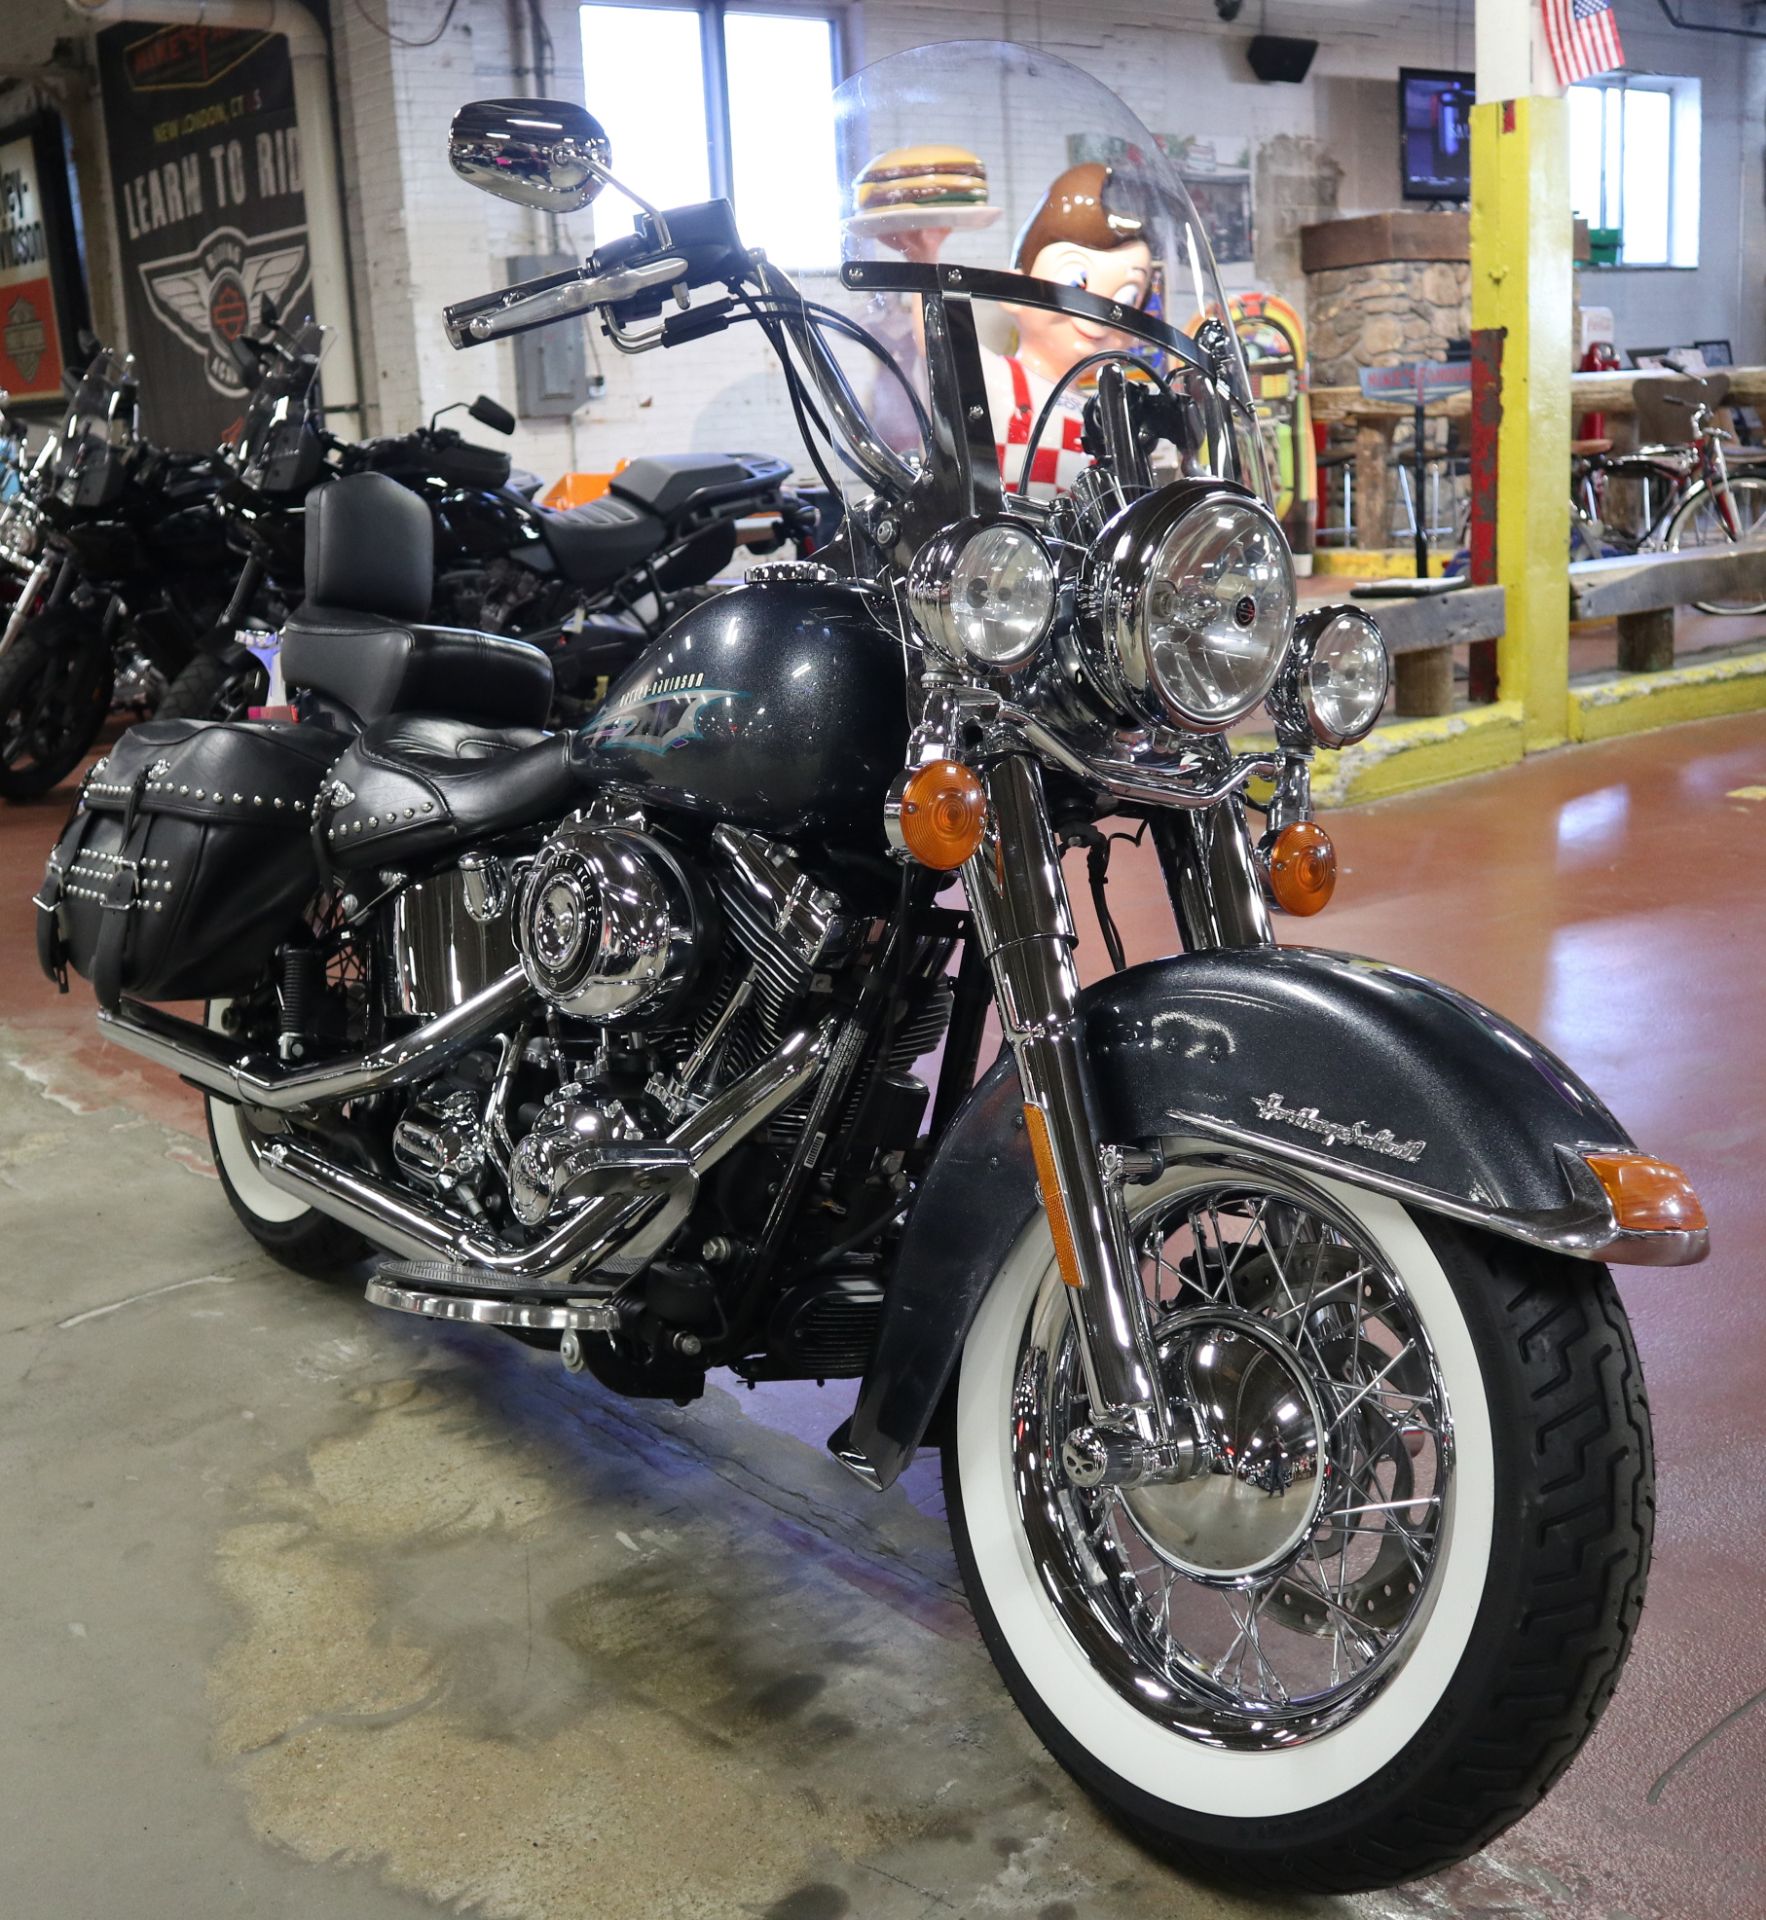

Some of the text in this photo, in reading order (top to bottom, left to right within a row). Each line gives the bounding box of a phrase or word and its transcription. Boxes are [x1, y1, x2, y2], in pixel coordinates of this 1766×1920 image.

[123, 127, 304, 240] LEARN TO RID
[572, 862, 596, 912] INCHES
